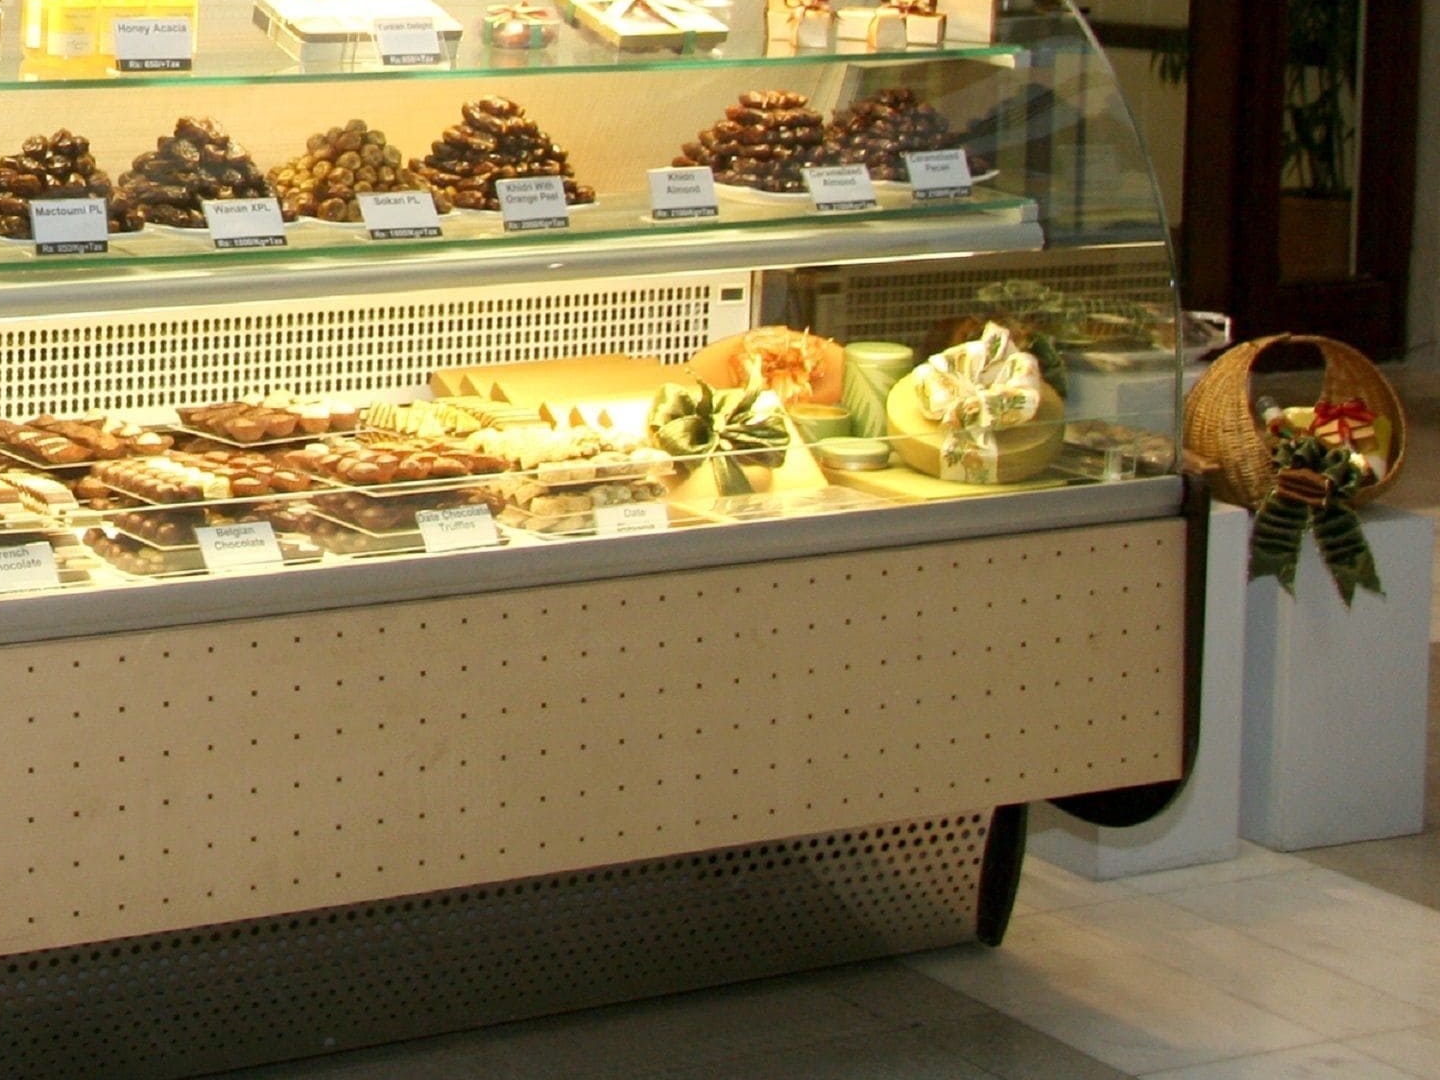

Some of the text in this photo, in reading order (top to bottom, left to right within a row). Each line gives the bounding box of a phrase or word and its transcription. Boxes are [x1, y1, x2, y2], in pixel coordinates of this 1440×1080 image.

[118, 22, 188, 35] Honey Acacia
[667, 185, 701, 194] Almond
[407, 195, 421, 205] PL
[505, 193, 538, 204] Orange
[34, 203, 104, 217] Mactoumi PL
[251, 202, 272, 213] XPL
[417, 506, 490, 524] Date Chocolate
[623, 507, 647, 518] Date
[215, 526, 256, 538] Belgian
[213, 539, 265, 551] Chocolate
